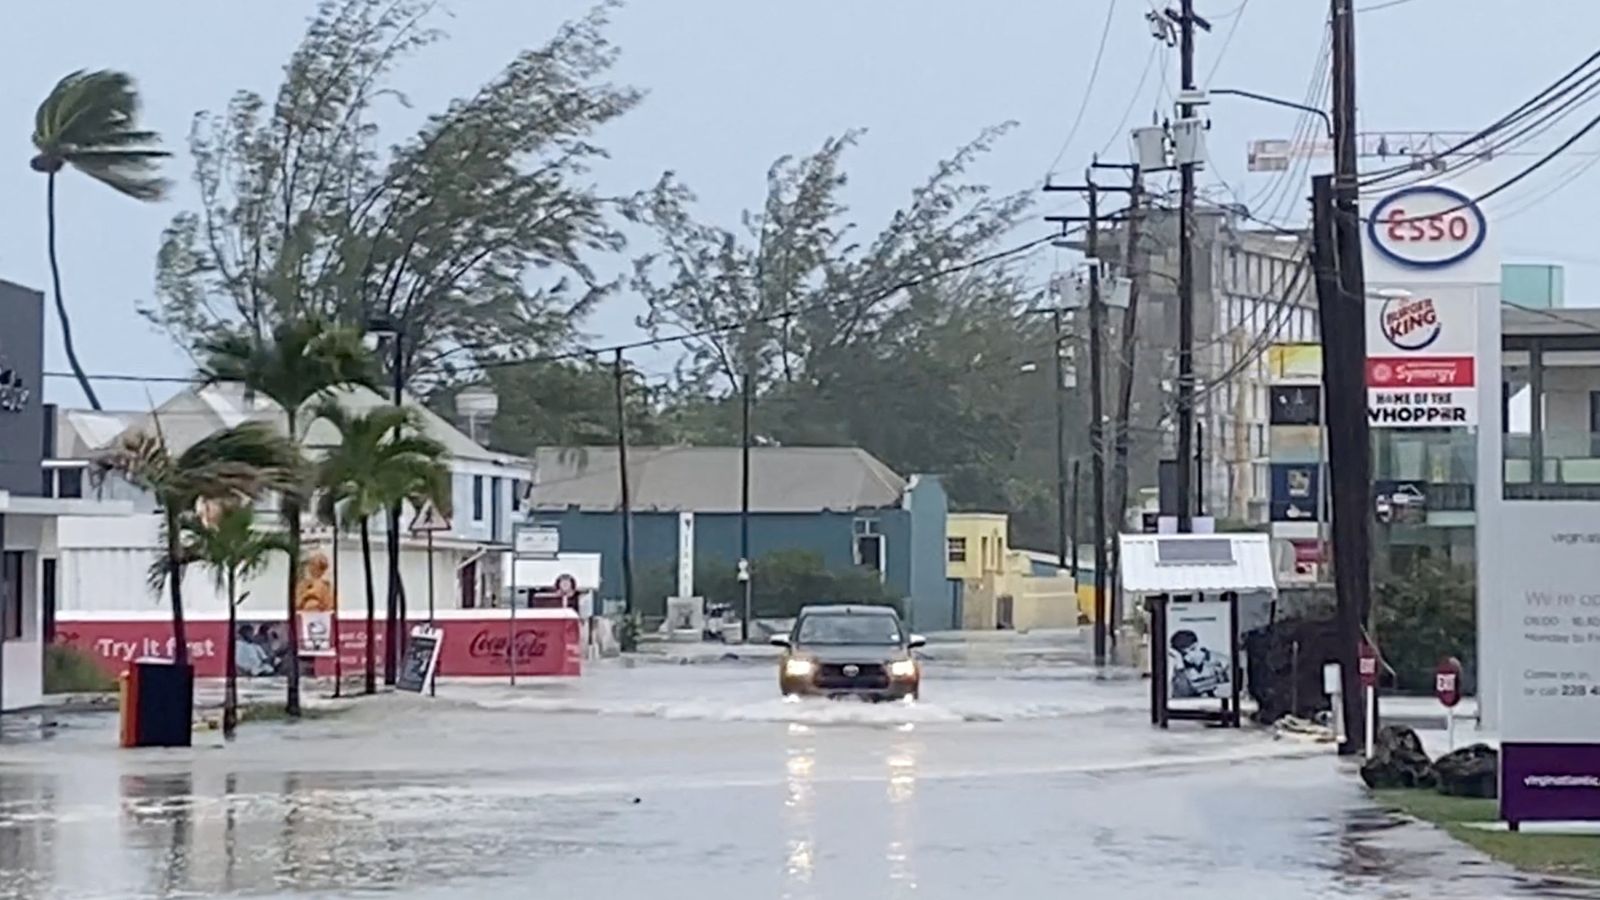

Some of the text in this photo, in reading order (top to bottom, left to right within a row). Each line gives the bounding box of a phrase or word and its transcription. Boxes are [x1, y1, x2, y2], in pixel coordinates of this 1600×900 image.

[1387, 209, 1469, 241] Esso
[1386, 298, 1434, 325] BURGER
[1389, 309, 1436, 340] KING
[1376, 393, 1452, 404] HOME OF THE
[97, 638, 138, 661] Try
